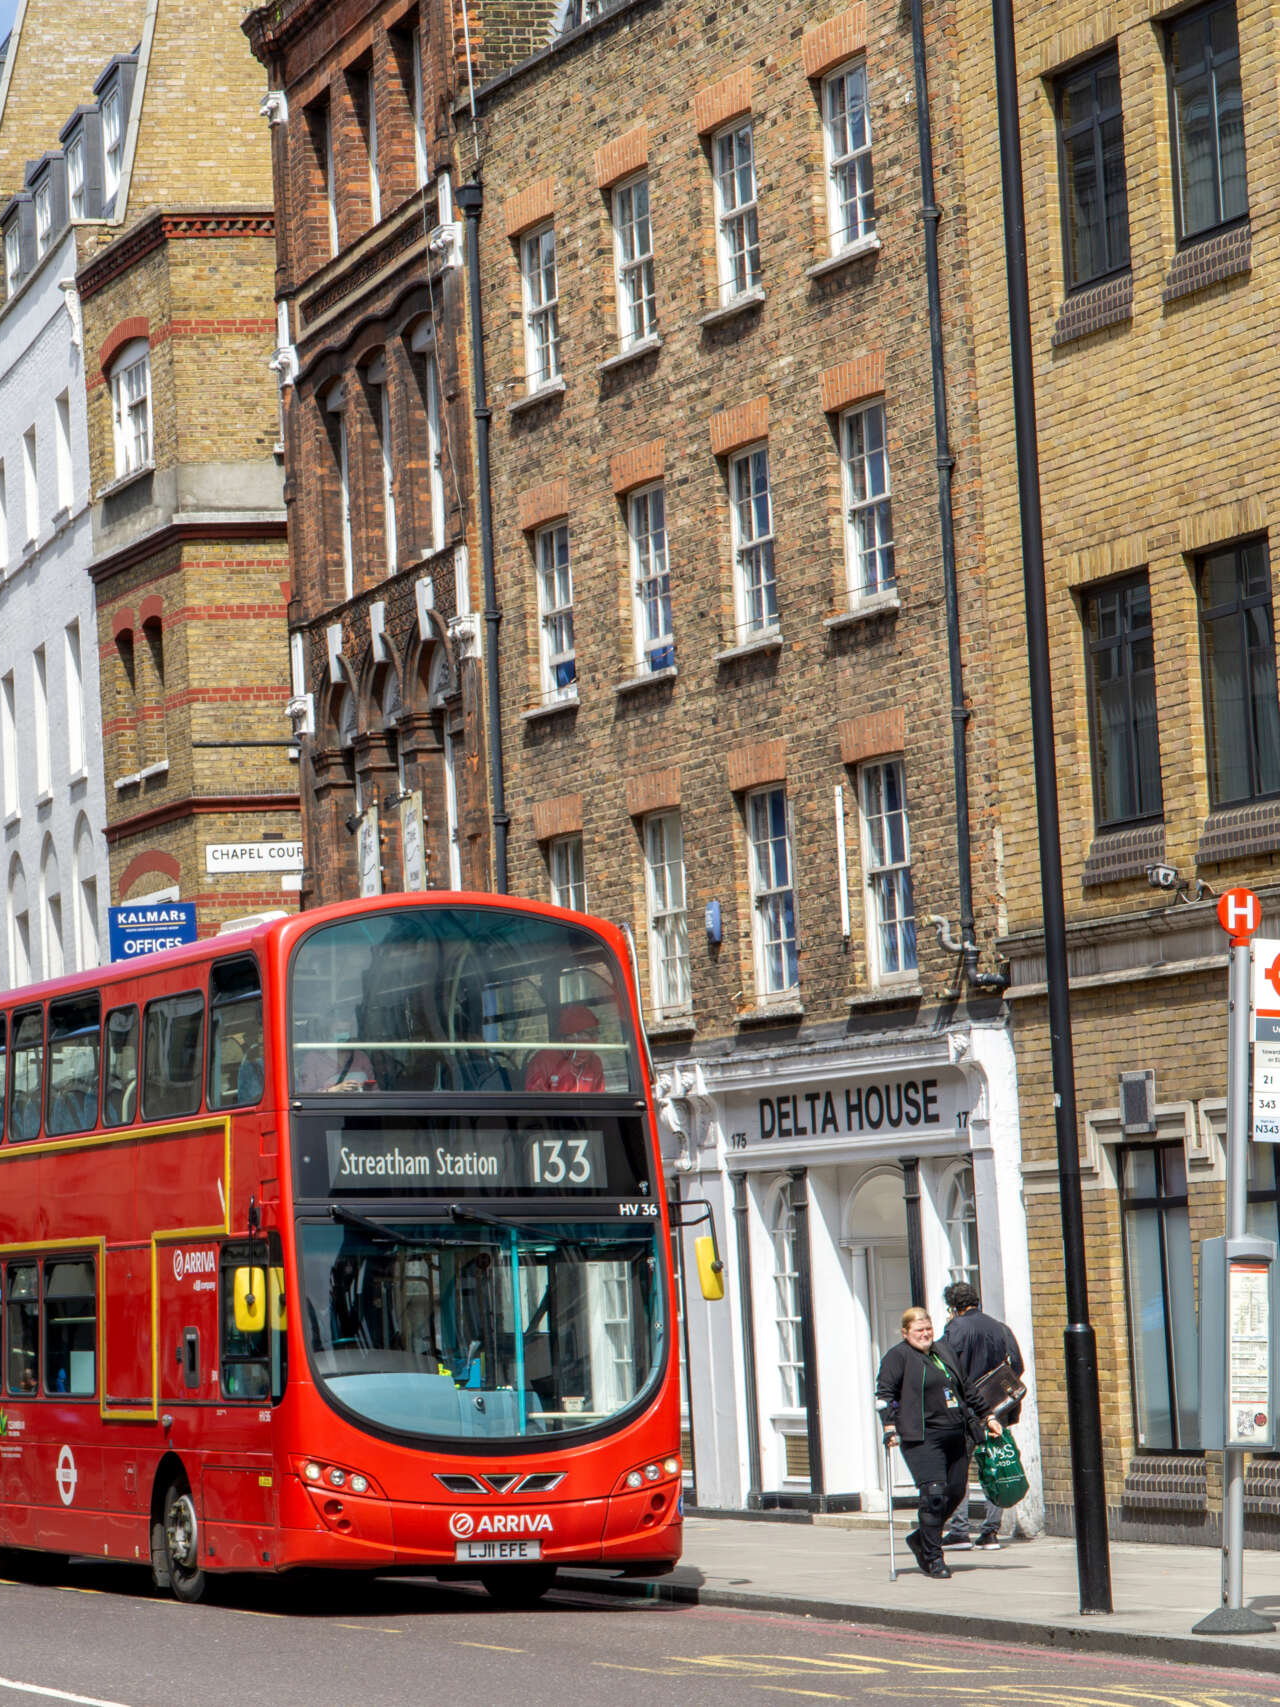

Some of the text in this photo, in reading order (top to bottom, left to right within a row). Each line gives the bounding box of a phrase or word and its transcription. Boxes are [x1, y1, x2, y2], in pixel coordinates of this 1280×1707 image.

[211, 846, 304, 860] CHAPEL COUR
[1227, 894, 1255, 930] H
[123, 937, 183, 954] OFFICES
[1263, 1075, 1273, 1085] 21
[759, 1079, 940, 1140] DELTA HOUSE
[1258, 1099, 1276, 1109] 343
[955, 1111, 970, 1129] 17
[1255, 1124, 1280, 1134] N343
[731, 1132, 747, 1150] 175
[340, 1139, 591, 1184] Streatham Station 133
[619, 1203, 658, 1217] HV 36
[183, 1251, 216, 1273] ARRIVA
[476, 1514, 554, 1533] ARRIVA
[468, 1542, 528, 1558] LJ11 EFE
